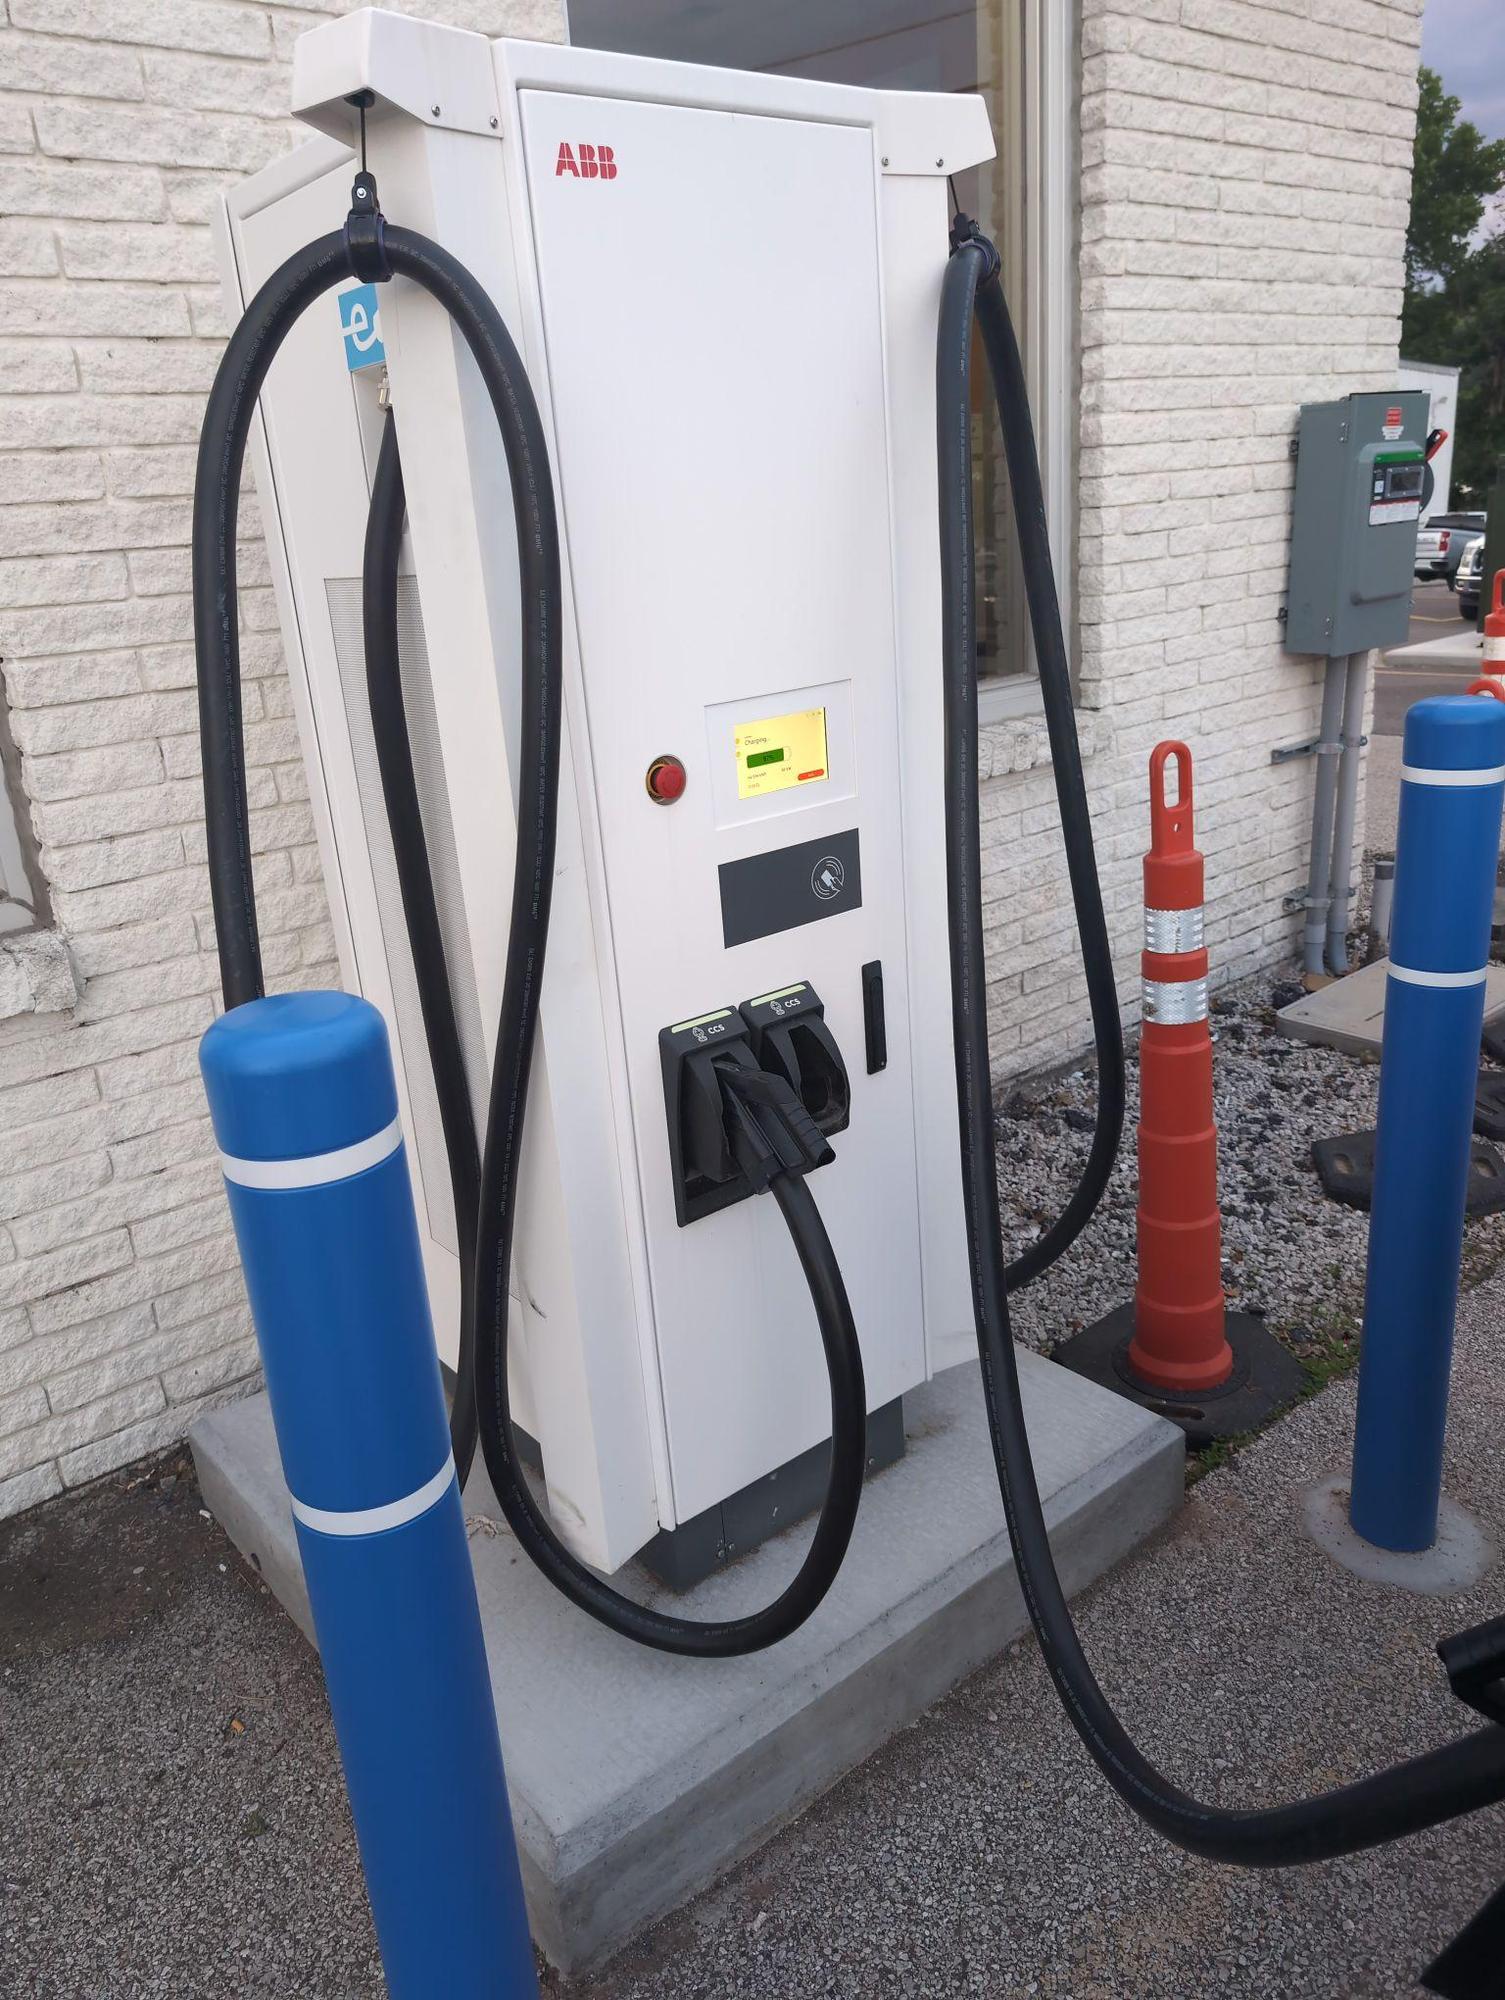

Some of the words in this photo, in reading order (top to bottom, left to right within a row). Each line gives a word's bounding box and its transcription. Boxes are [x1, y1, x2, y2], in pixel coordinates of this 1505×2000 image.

[555, 142, 618, 180] ABB
[784, 998, 801, 1008] CCS
[707, 1023, 725, 1034] CCS
